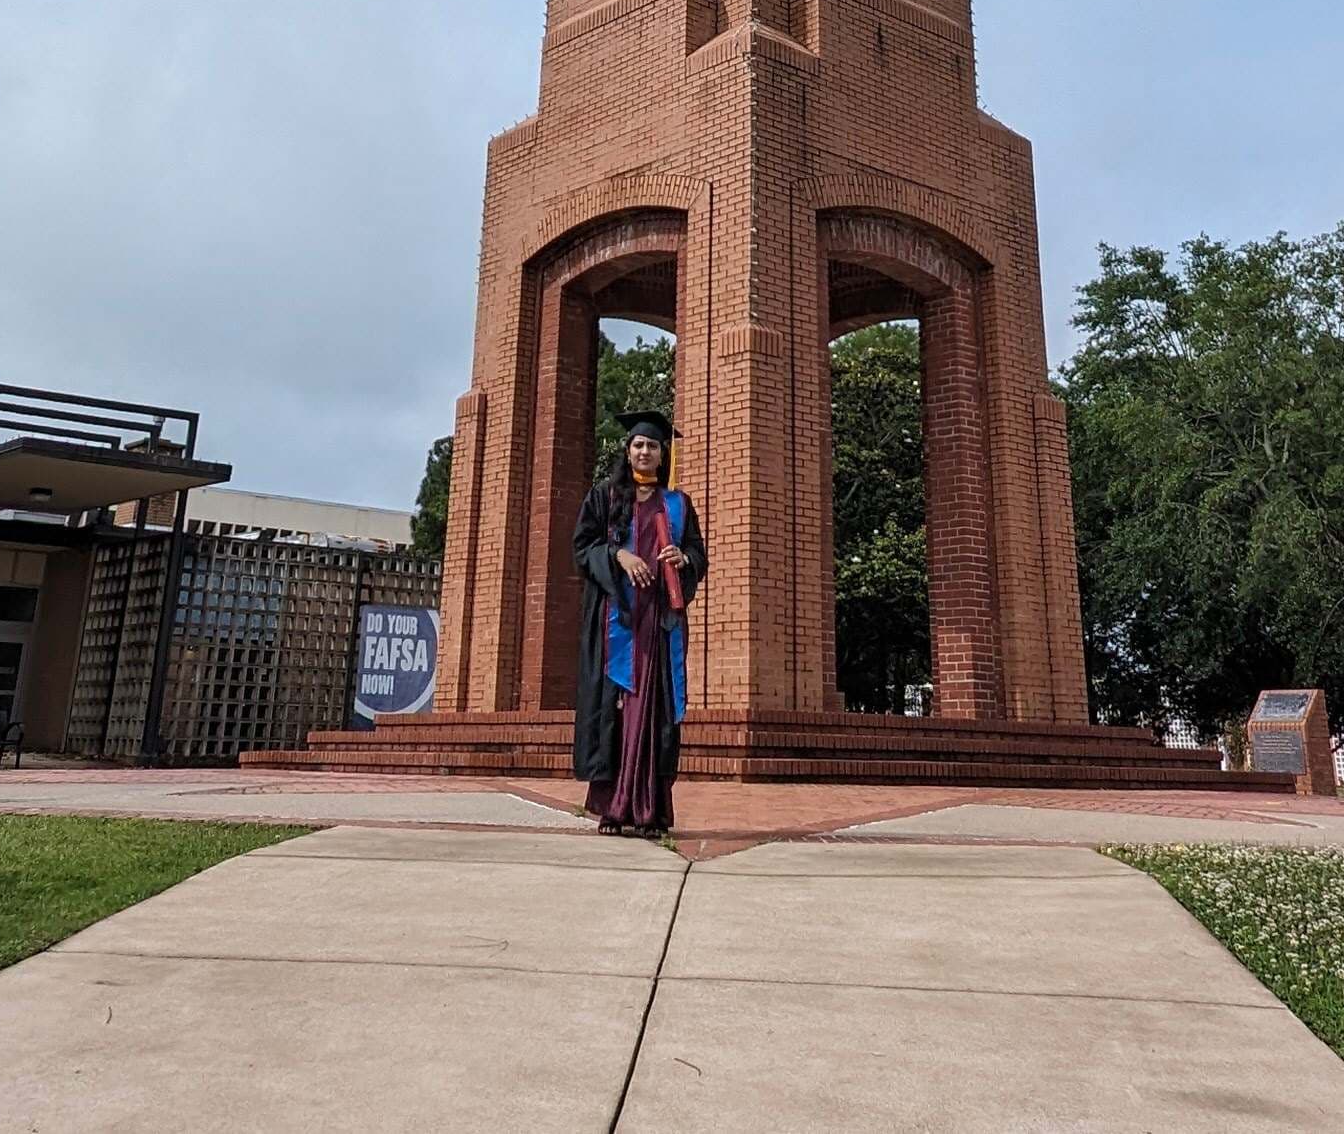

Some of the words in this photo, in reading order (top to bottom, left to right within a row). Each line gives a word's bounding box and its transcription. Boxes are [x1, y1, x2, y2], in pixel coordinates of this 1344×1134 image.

[366, 613, 383, 633] DO
[387, 614, 418, 635] YOUR
[364, 636, 428, 672] FAFSA
[361, 674, 394, 695] NOW!
